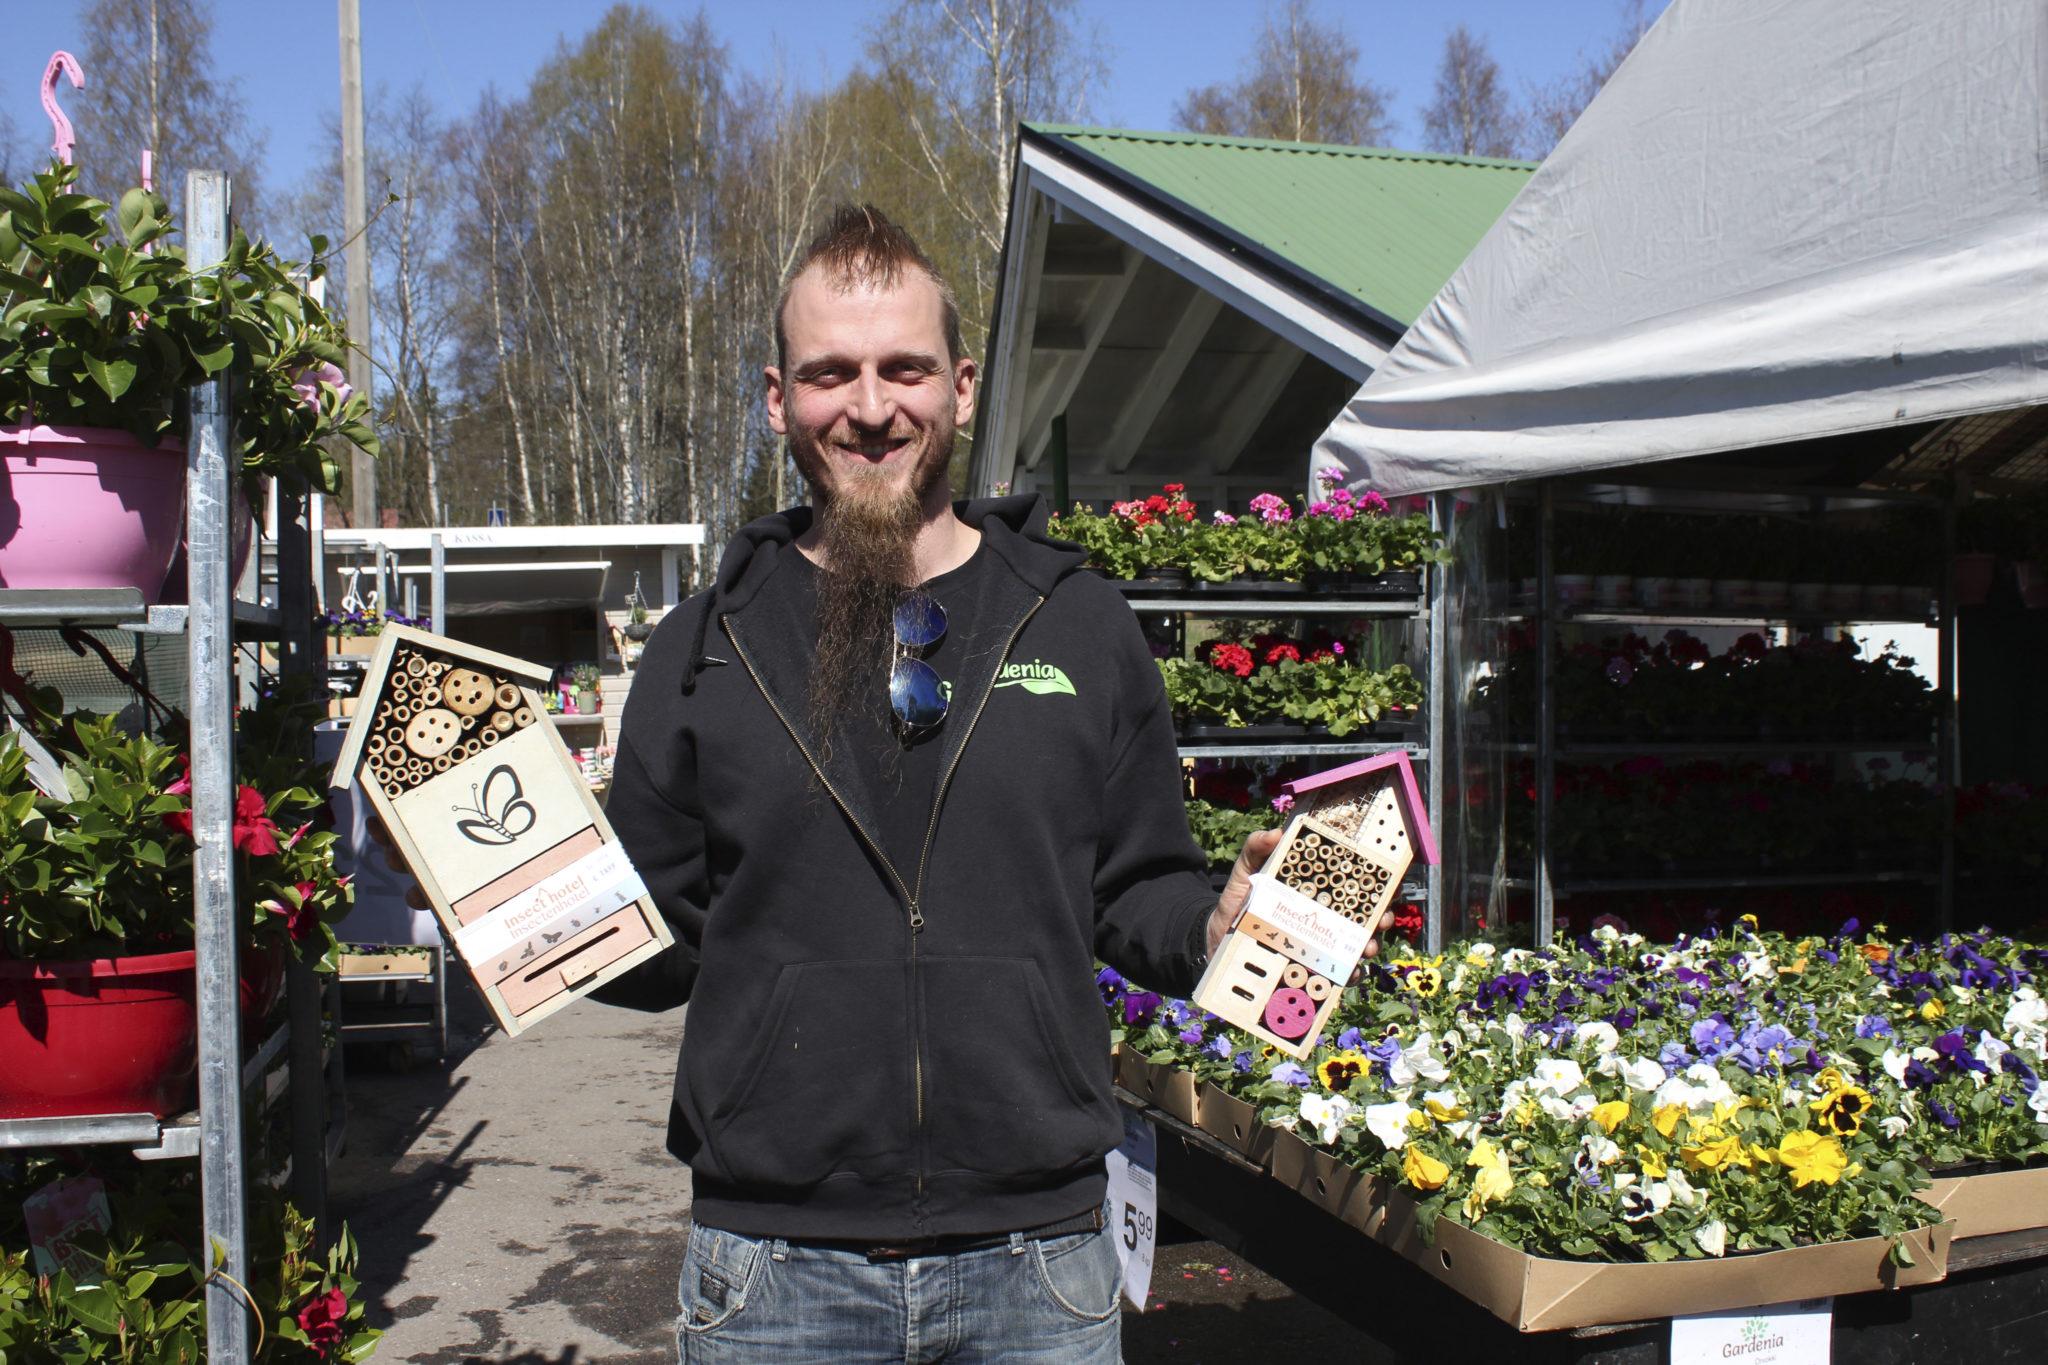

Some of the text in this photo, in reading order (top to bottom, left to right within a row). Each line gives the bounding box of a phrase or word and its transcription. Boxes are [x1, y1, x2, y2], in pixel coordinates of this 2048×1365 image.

[503, 874, 585, 929] Insect hotel
[509, 885, 592, 939] Insectenhotel
[1275, 901, 1310, 925] Insect
[1722, 1333, 1784, 1358] Gardenia
